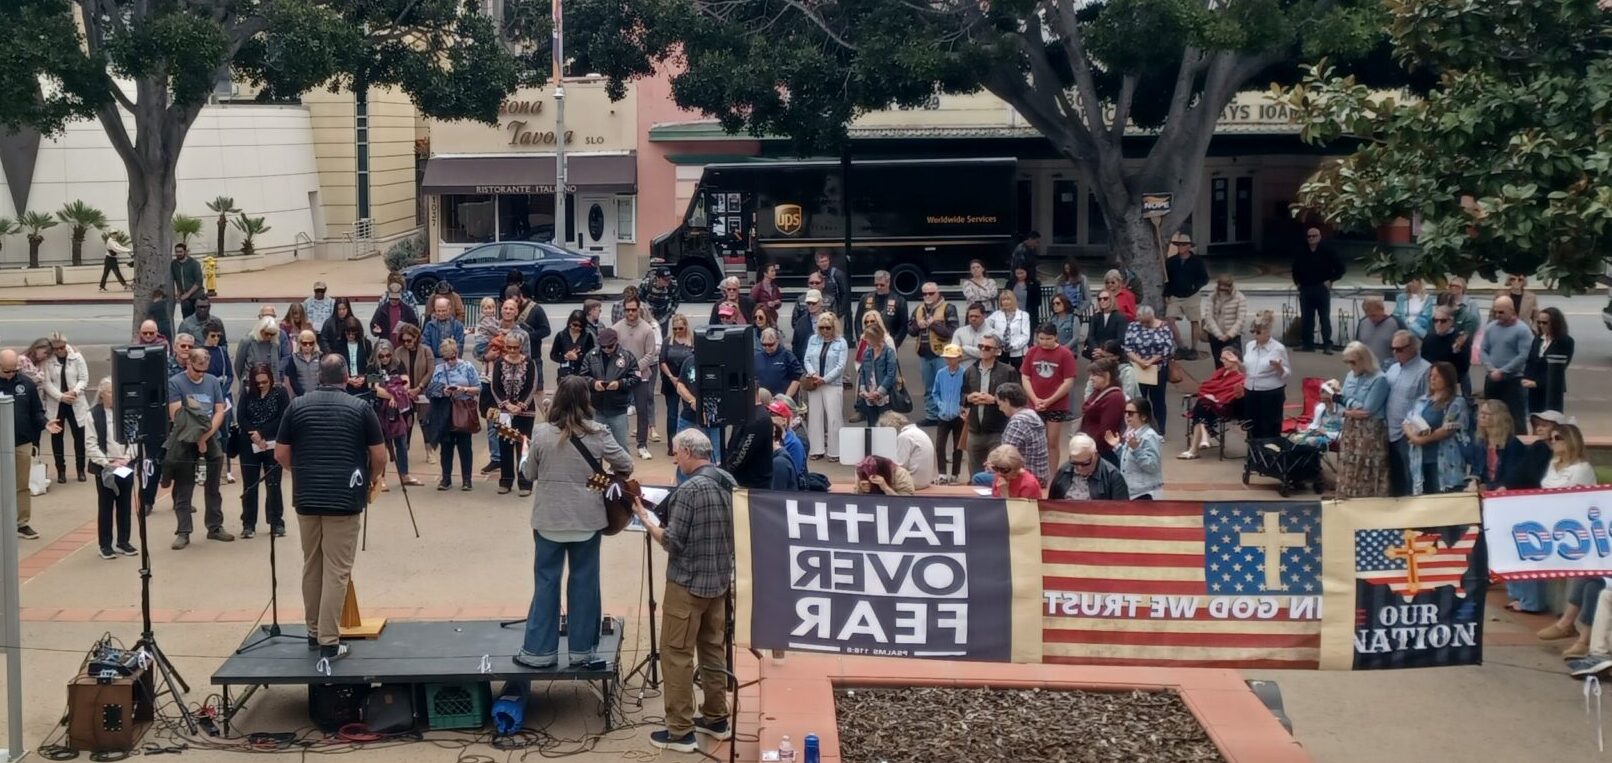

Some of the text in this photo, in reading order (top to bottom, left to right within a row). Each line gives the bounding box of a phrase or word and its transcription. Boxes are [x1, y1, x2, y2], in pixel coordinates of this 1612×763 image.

[507, 120, 574, 146] Tavoa
[585, 136, 604, 145] SLO
[476, 185, 577, 193] RISTORANTE ITALINO
[1143, 201, 1170, 209] NOPE
[926, 215, 997, 224] Worldwide Services
[1379, 603, 1440, 626] OUR
[1353, 622, 1478, 654] NATION
